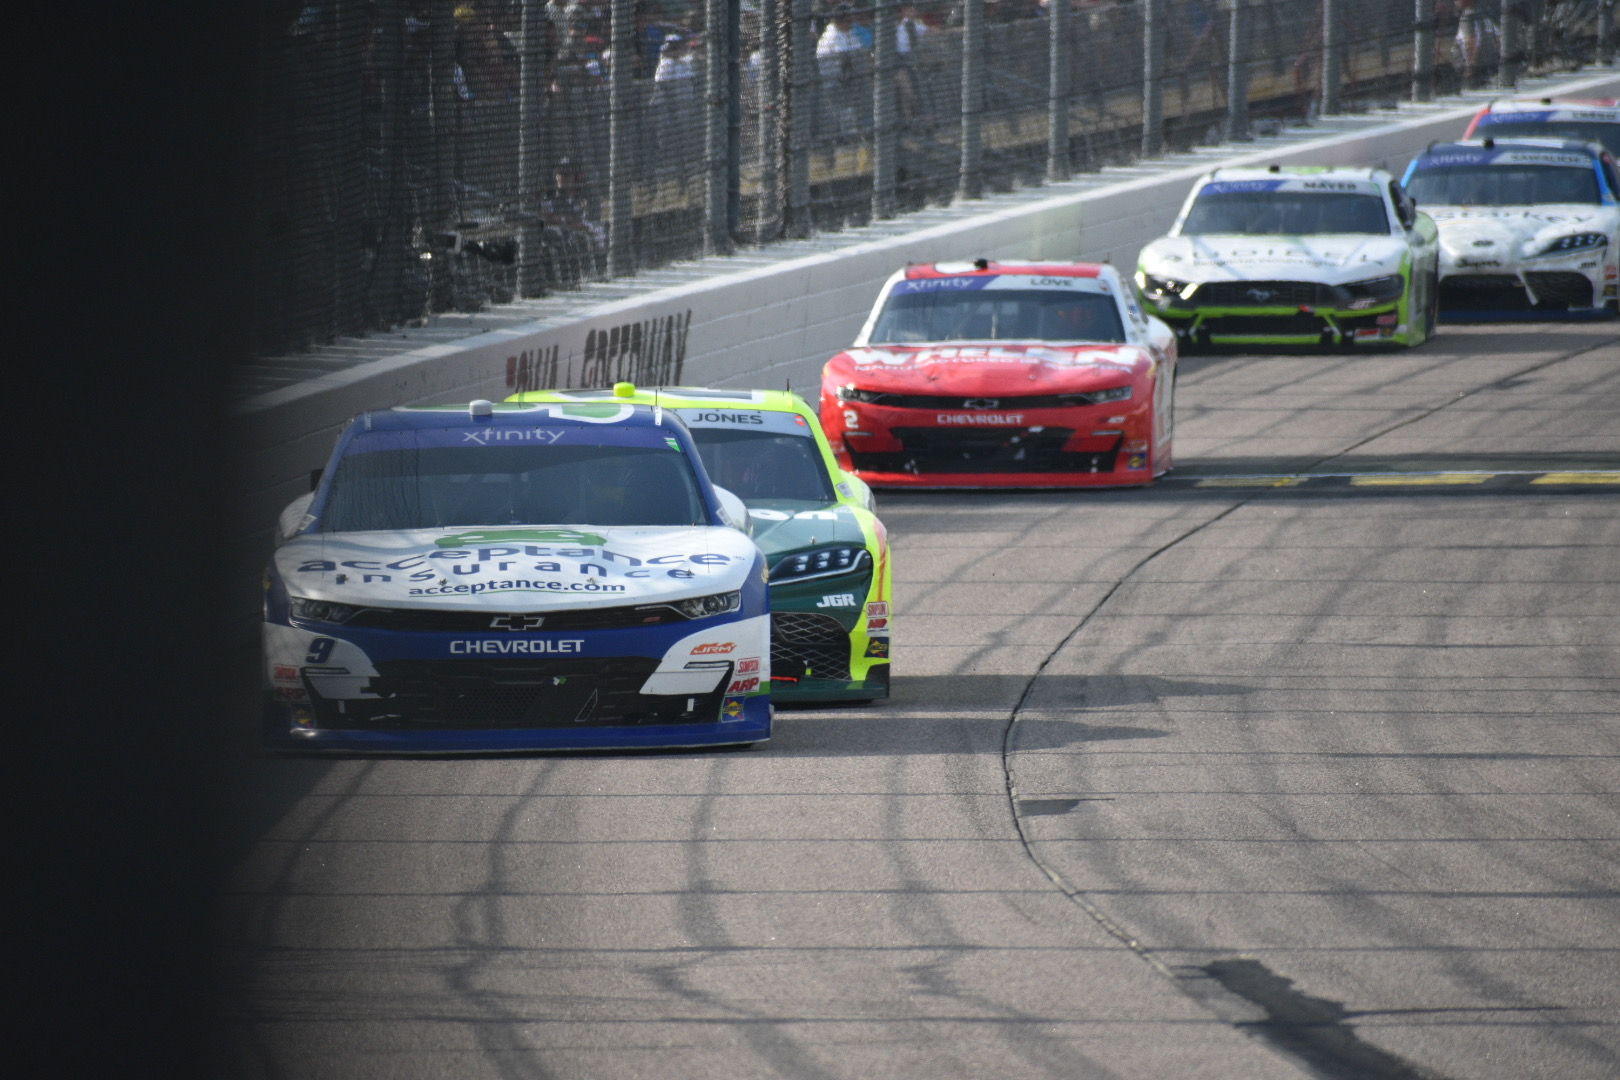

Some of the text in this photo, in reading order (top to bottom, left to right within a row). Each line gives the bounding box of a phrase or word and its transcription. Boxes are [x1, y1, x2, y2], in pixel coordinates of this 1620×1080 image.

[906, 277, 975, 291] xfinity
[1030, 277, 1073, 287] LOVE
[692, 411, 764, 426] JONES
[842, 409, 860, 429] 2
[936, 413, 1025, 425] CHEVROLET
[462, 427, 566, 446] xfinity
[297, 547, 731, 573] acceptance
[408, 578, 626, 595] acceptance.com
[816, 593, 857, 608] JGR
[306, 636, 335, 664] 9
[449, 639, 585, 655] CHEVROLET
[693, 645, 733, 654] JRM
[727, 676, 760, 693] ARP
